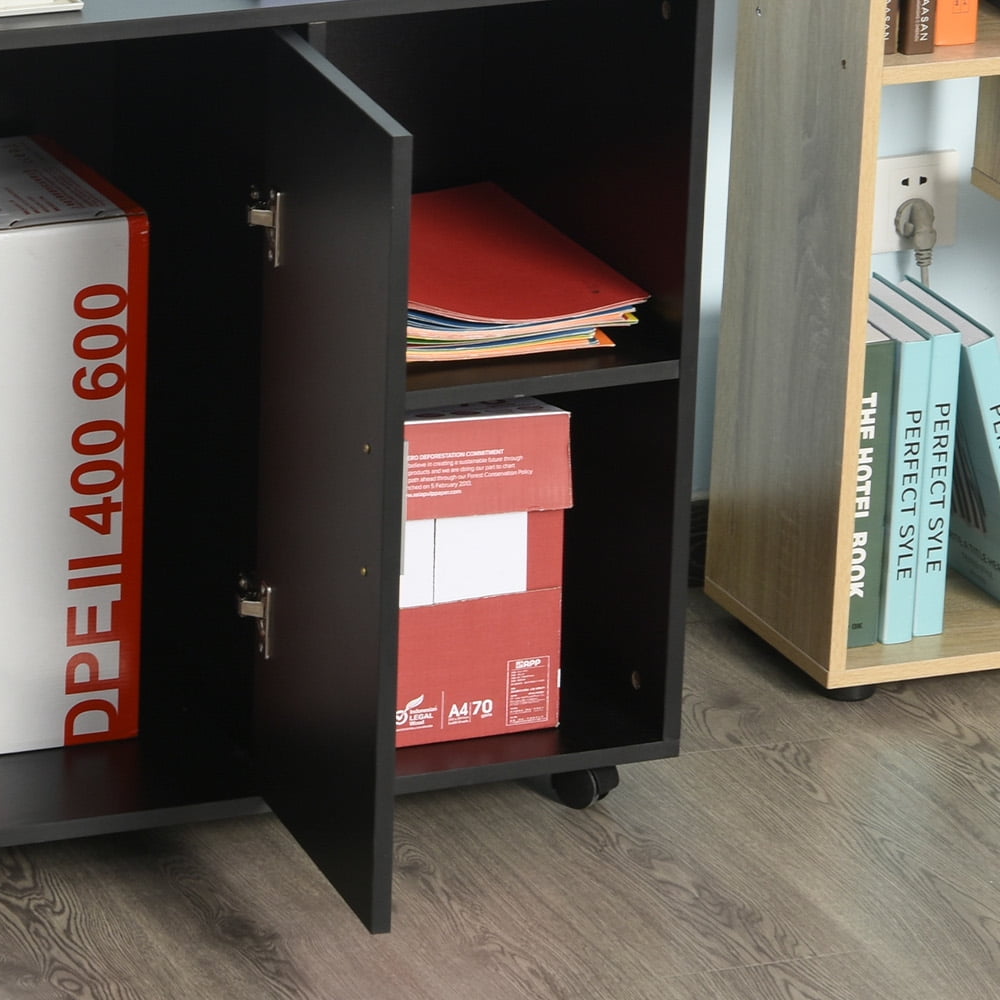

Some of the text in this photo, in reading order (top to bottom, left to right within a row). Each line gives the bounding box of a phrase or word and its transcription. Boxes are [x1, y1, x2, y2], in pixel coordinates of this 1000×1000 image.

[860, 392, 878, 439] THE
[64, 283, 129, 746] DPEII 400 600
[897, 410, 922, 580] PERFECT SYLE
[926, 403, 951, 573] PERFECT SYLE
[849, 531, 868, 598] BOOK
[448, 699, 493, 717] A4 70
